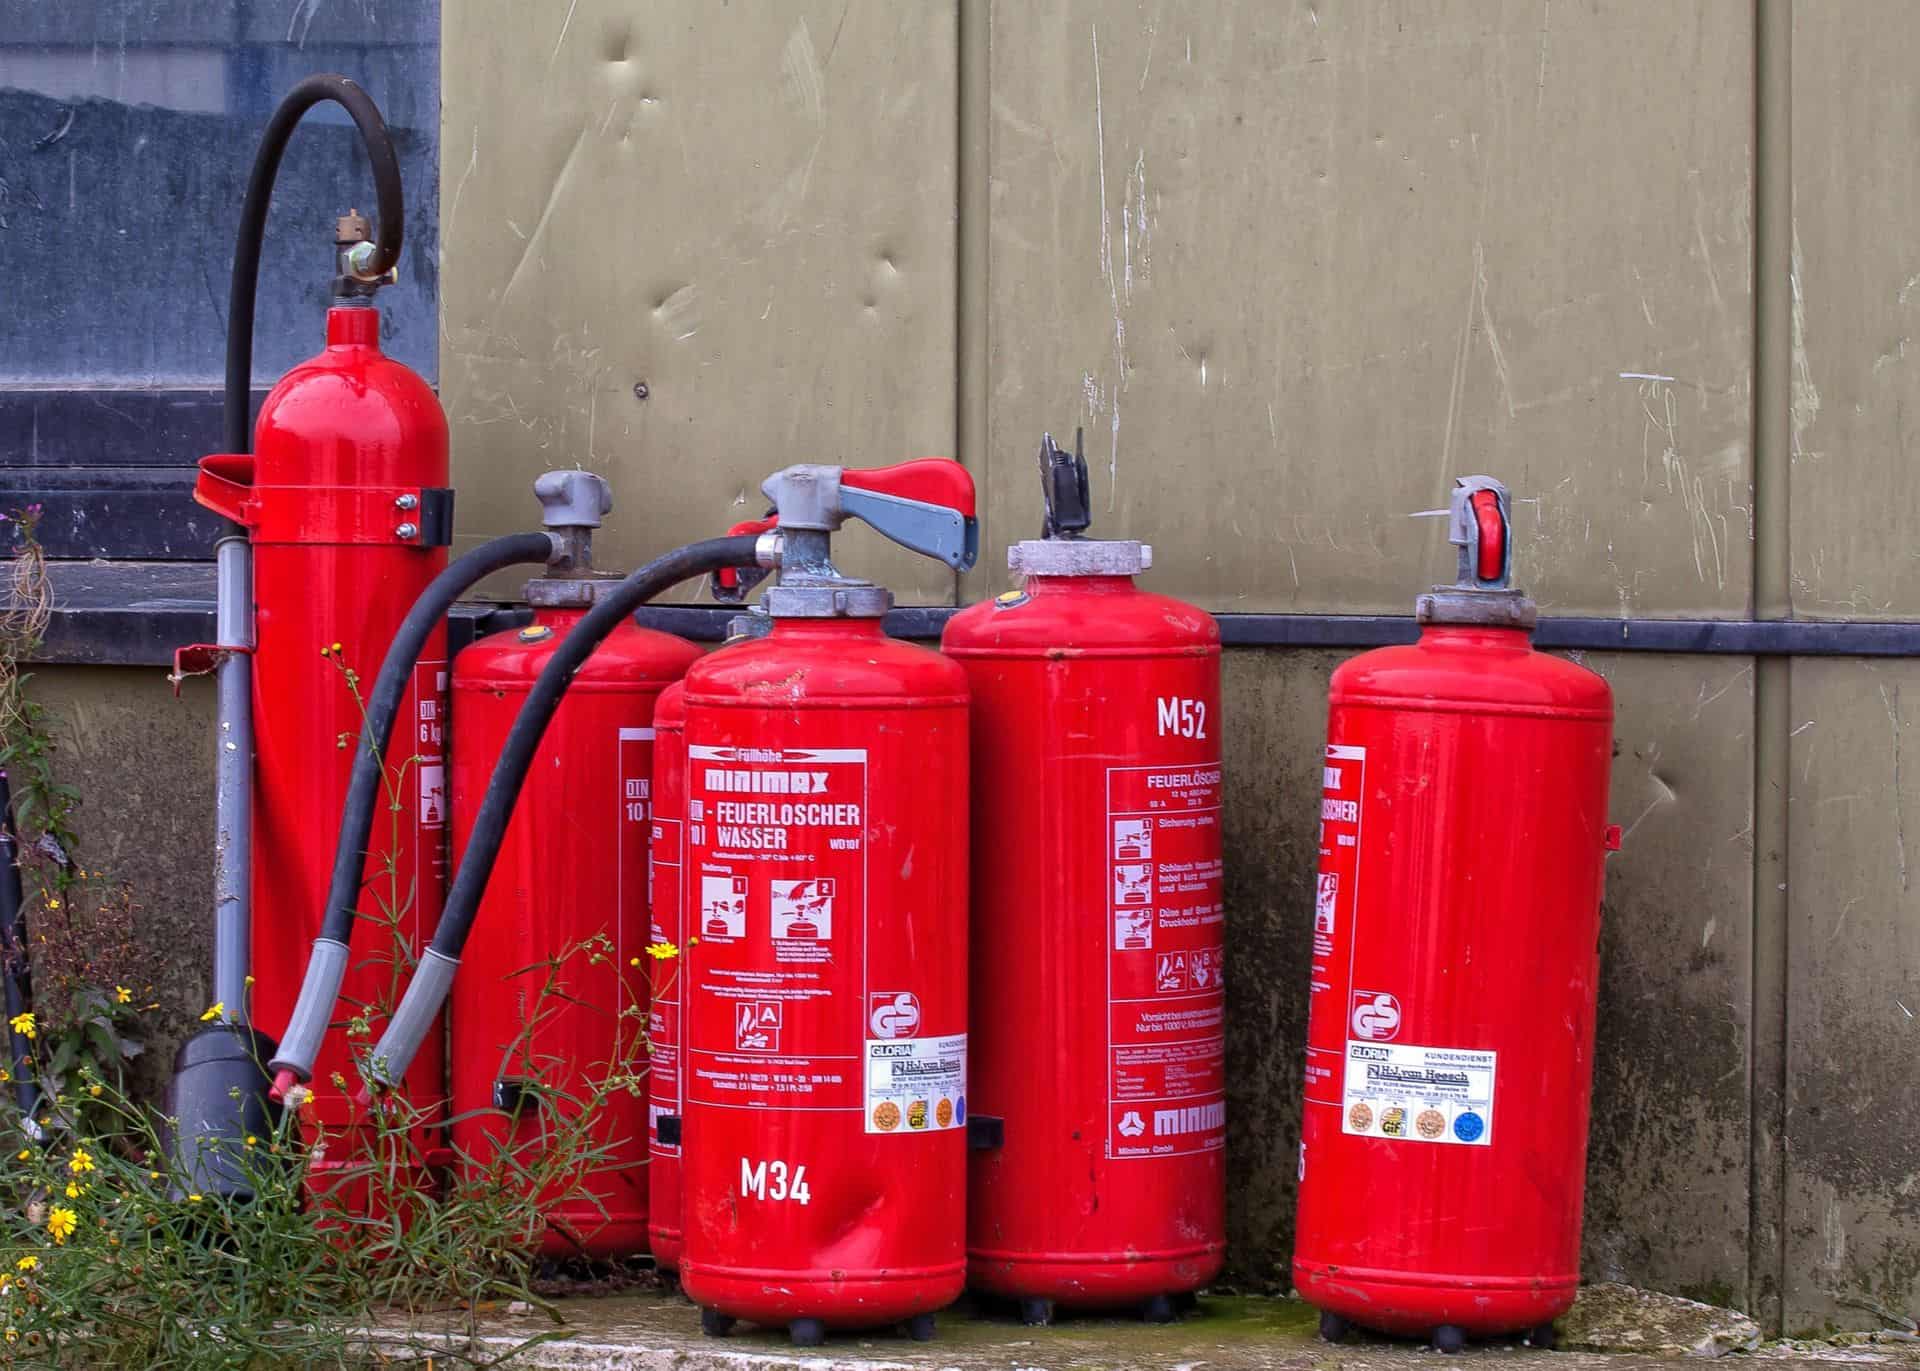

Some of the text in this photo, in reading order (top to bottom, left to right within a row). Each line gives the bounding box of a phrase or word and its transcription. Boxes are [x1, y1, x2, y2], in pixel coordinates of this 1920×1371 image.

[1157, 696, 1206, 739] M52
[420, 724, 427, 742] 6
[626, 779, 648, 798] DIN
[705, 769, 829, 794] minimax
[626, 803, 643, 822] 10
[717, 825, 787, 849] WASSER
[821, 882, 829, 893] 2
[1176, 956, 1185, 969] A
[760, 1008, 776, 1022] A
[871, 1045, 912, 1058] GLORIA
[1424, 1052, 1493, 1063] KUNDENDIENST
[1425, 1069, 1468, 1081] Heesch
[740, 1157, 811, 1206] M34
